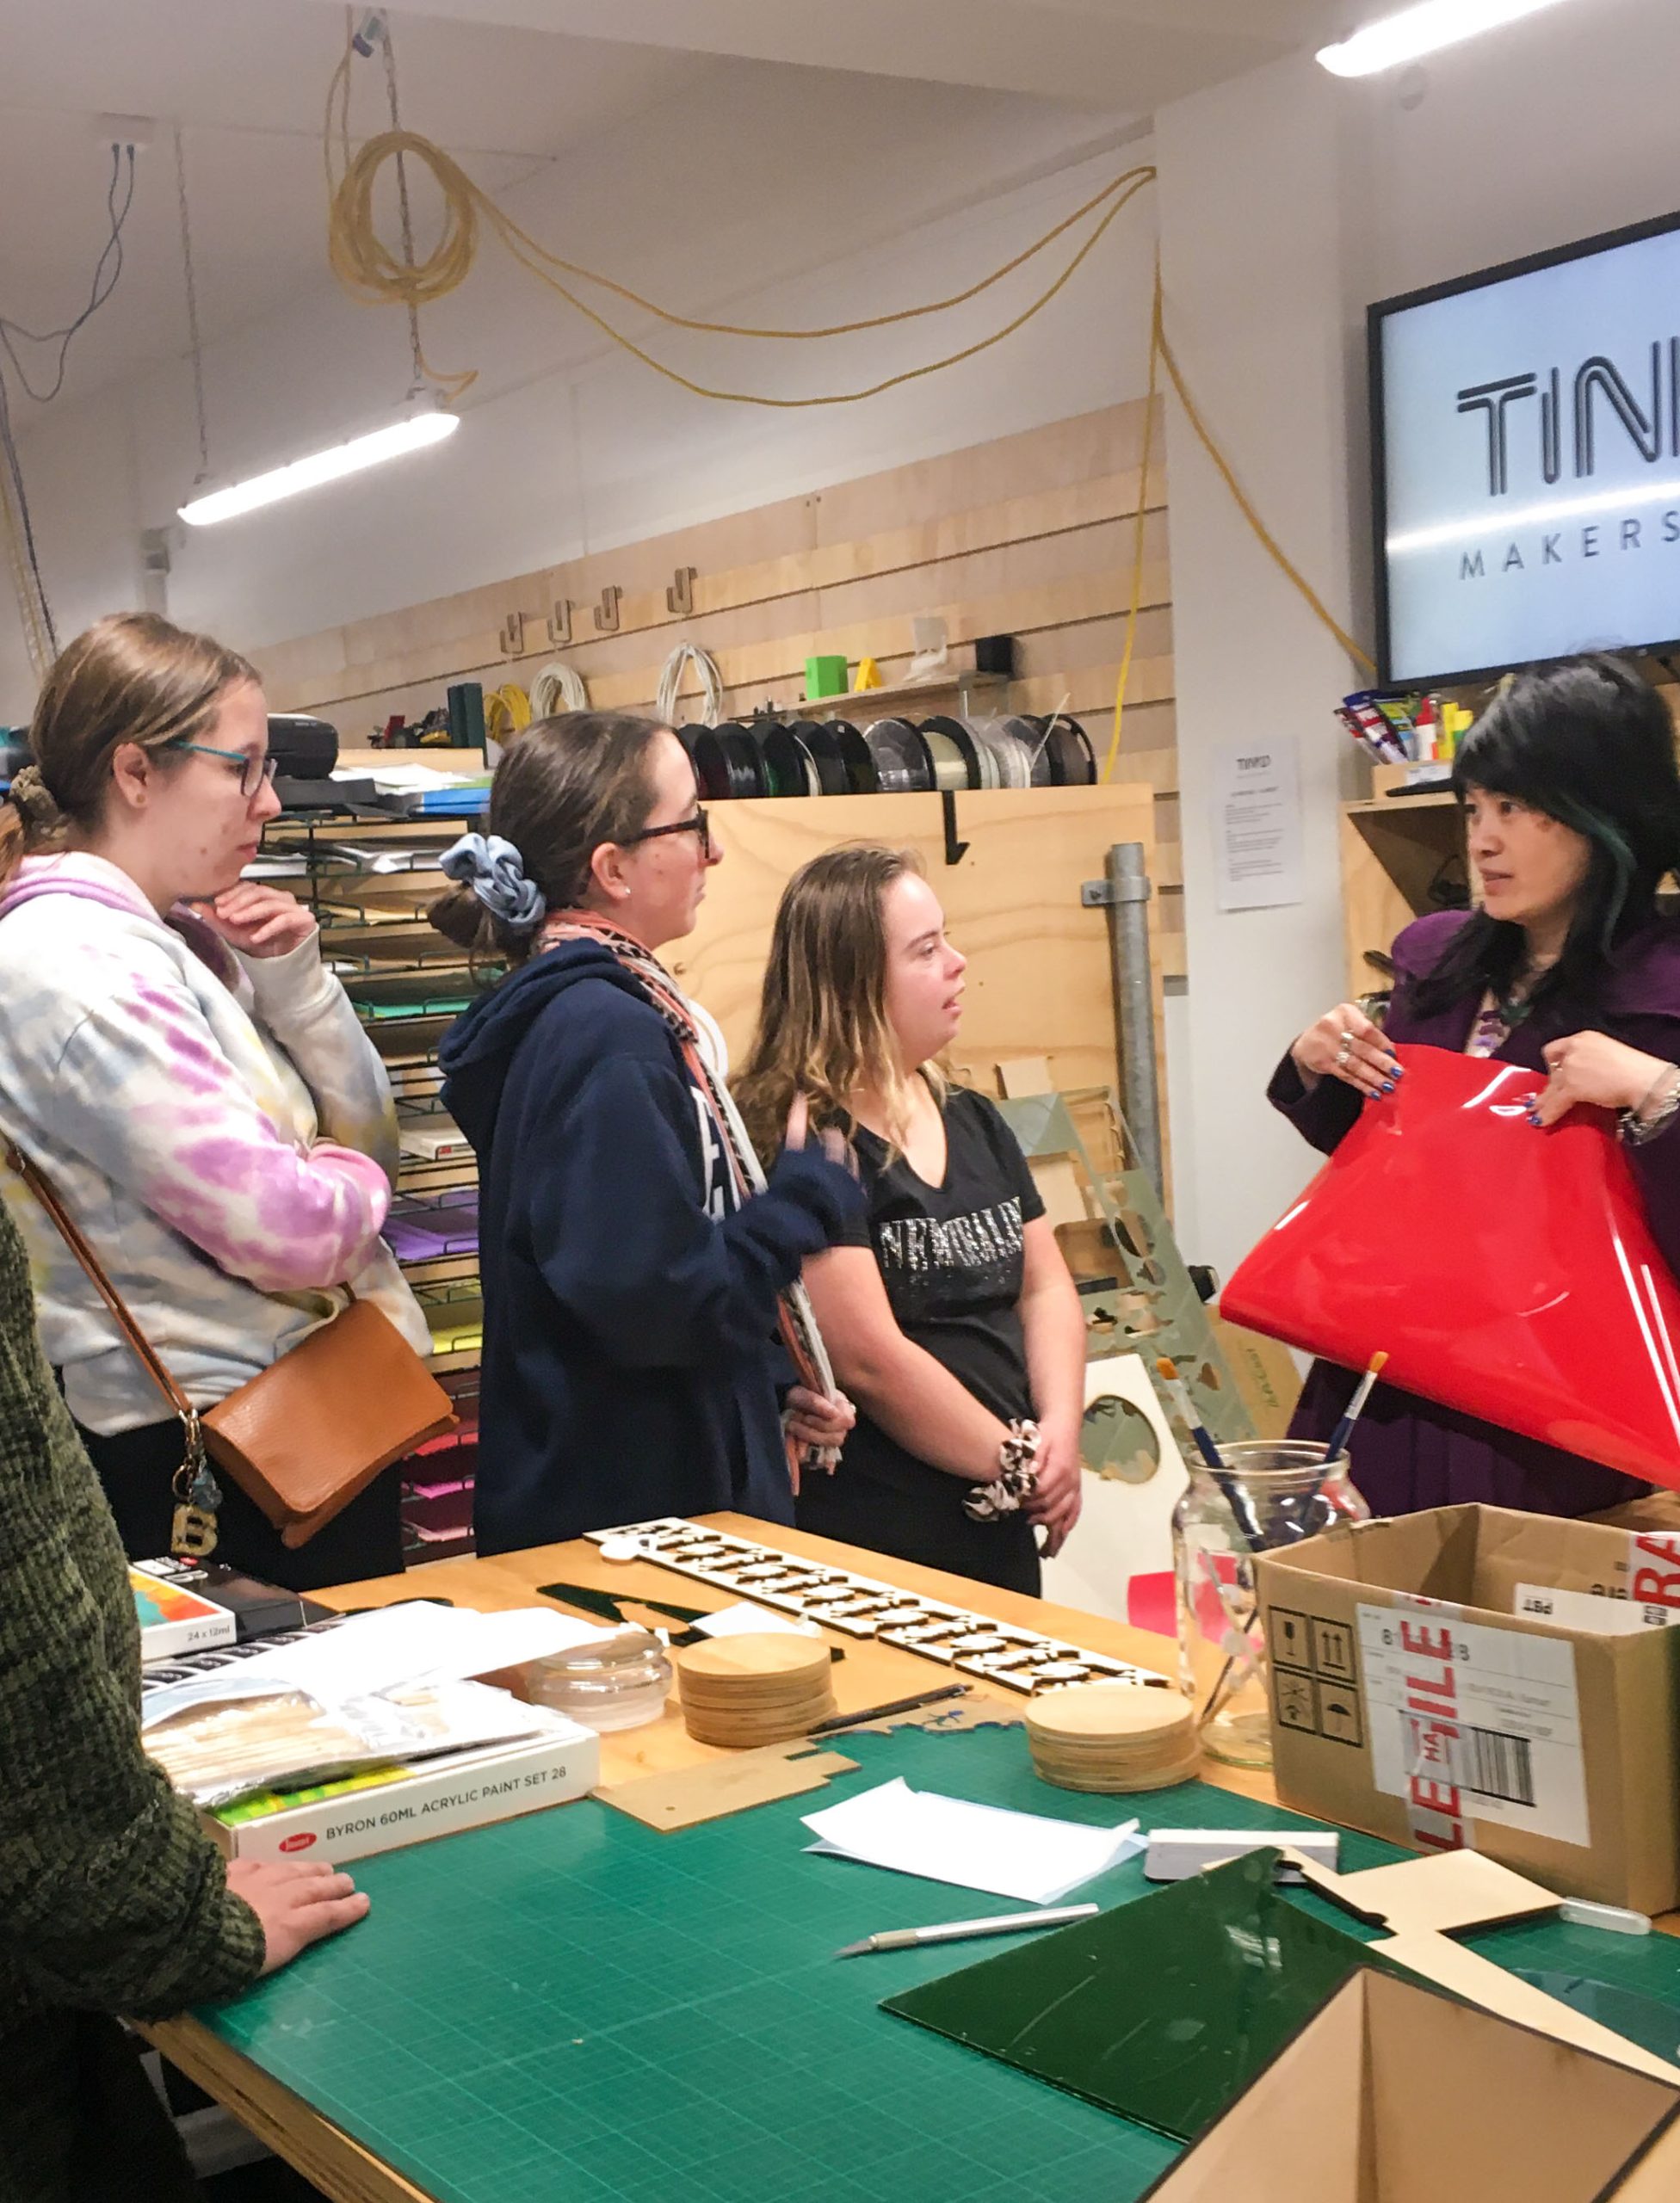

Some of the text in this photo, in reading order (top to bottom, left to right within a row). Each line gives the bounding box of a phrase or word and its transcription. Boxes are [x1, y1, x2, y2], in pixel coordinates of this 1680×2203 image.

[1459, 509, 1680, 581] MAKERS
[171, 1503, 218, 1557] B
[187, 1631, 200, 1642] 24
[209, 1625, 230, 1637] 12ml
[326, 1766, 566, 1840] BYRON 60ML ACRYLIC PAINT SET 28
